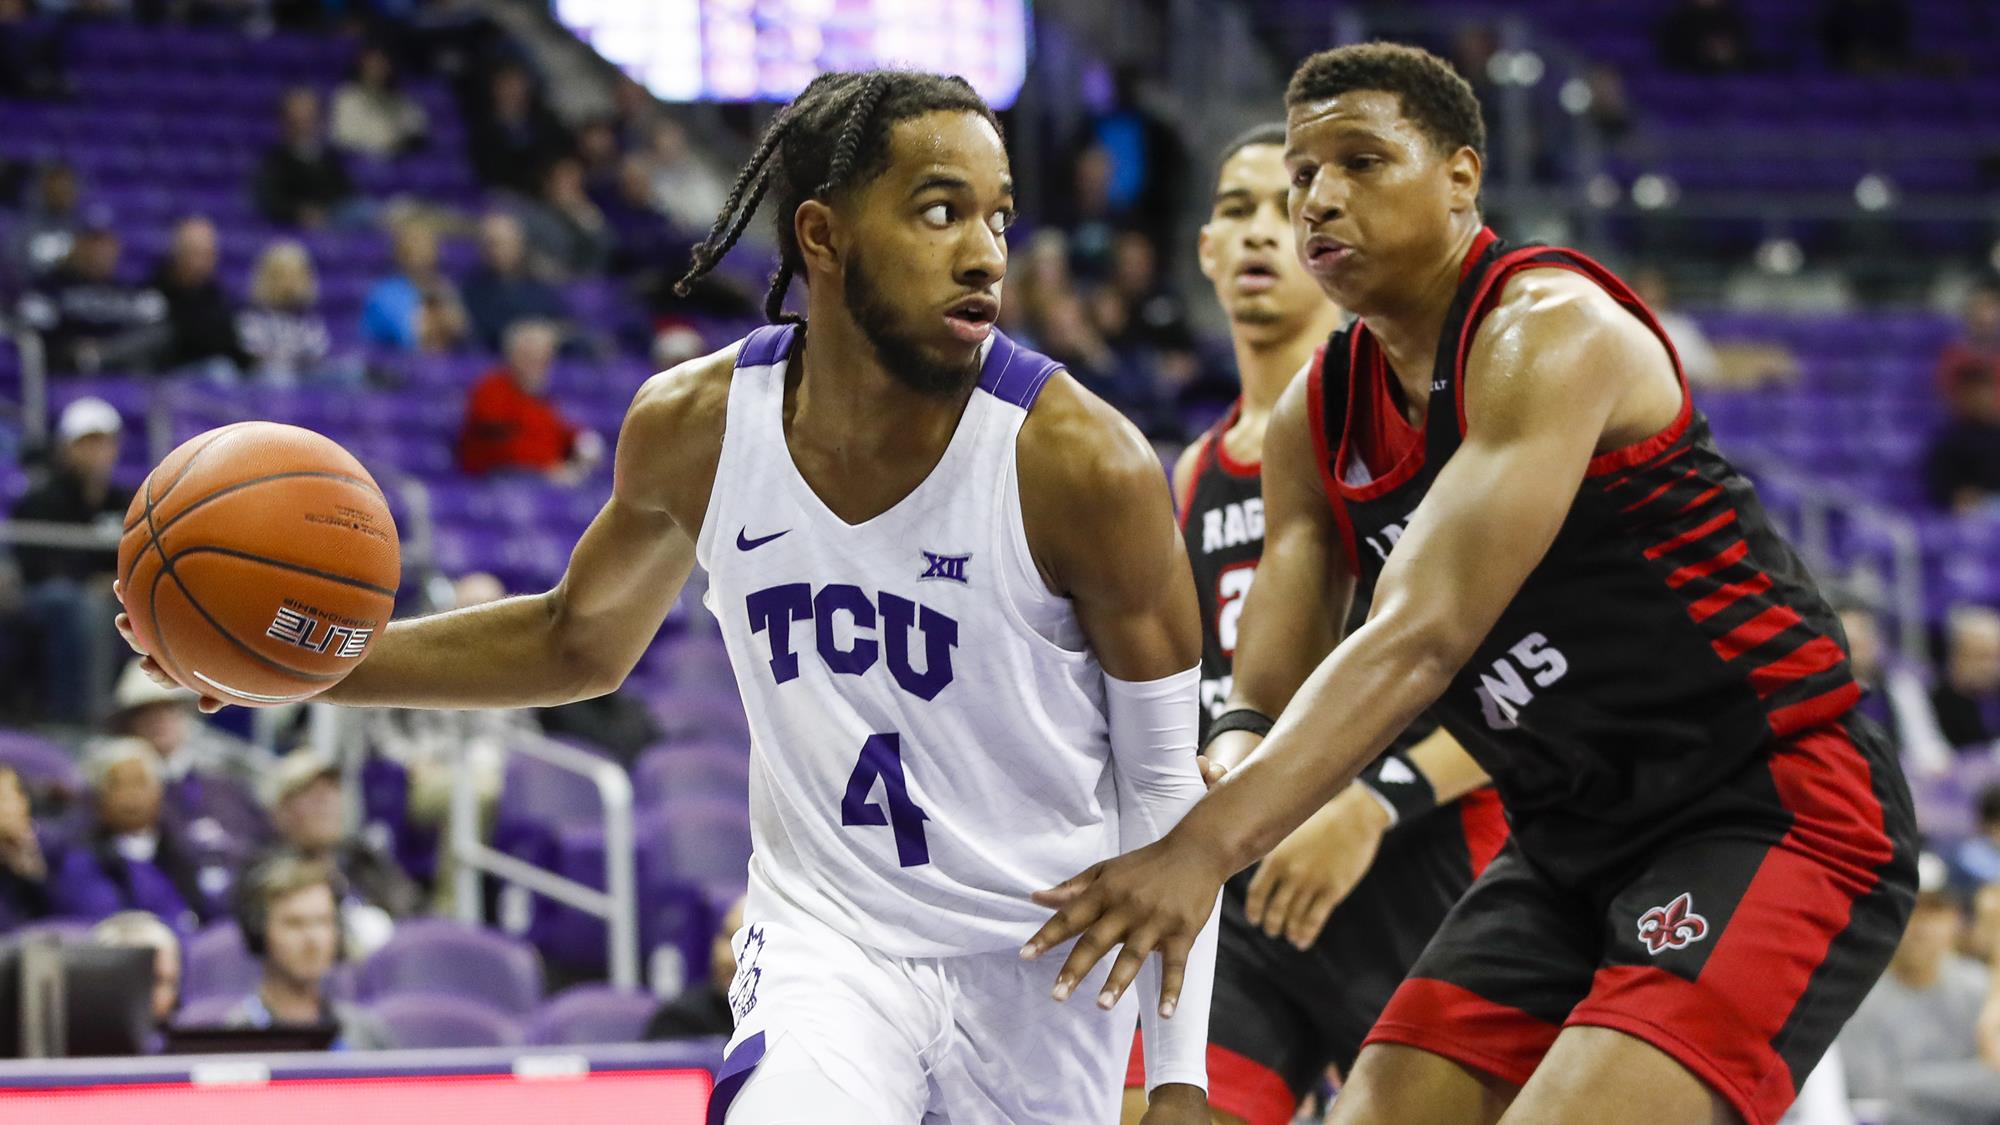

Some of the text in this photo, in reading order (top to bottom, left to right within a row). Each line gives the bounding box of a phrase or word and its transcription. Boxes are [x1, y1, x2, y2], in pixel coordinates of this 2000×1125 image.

[921, 551, 970, 584] XII
[266, 606, 374, 658] ELITE
[283, 598, 378, 627] CHAMPIONSHIP
[746, 583, 958, 702] TCU
[841, 732, 931, 868] 4
